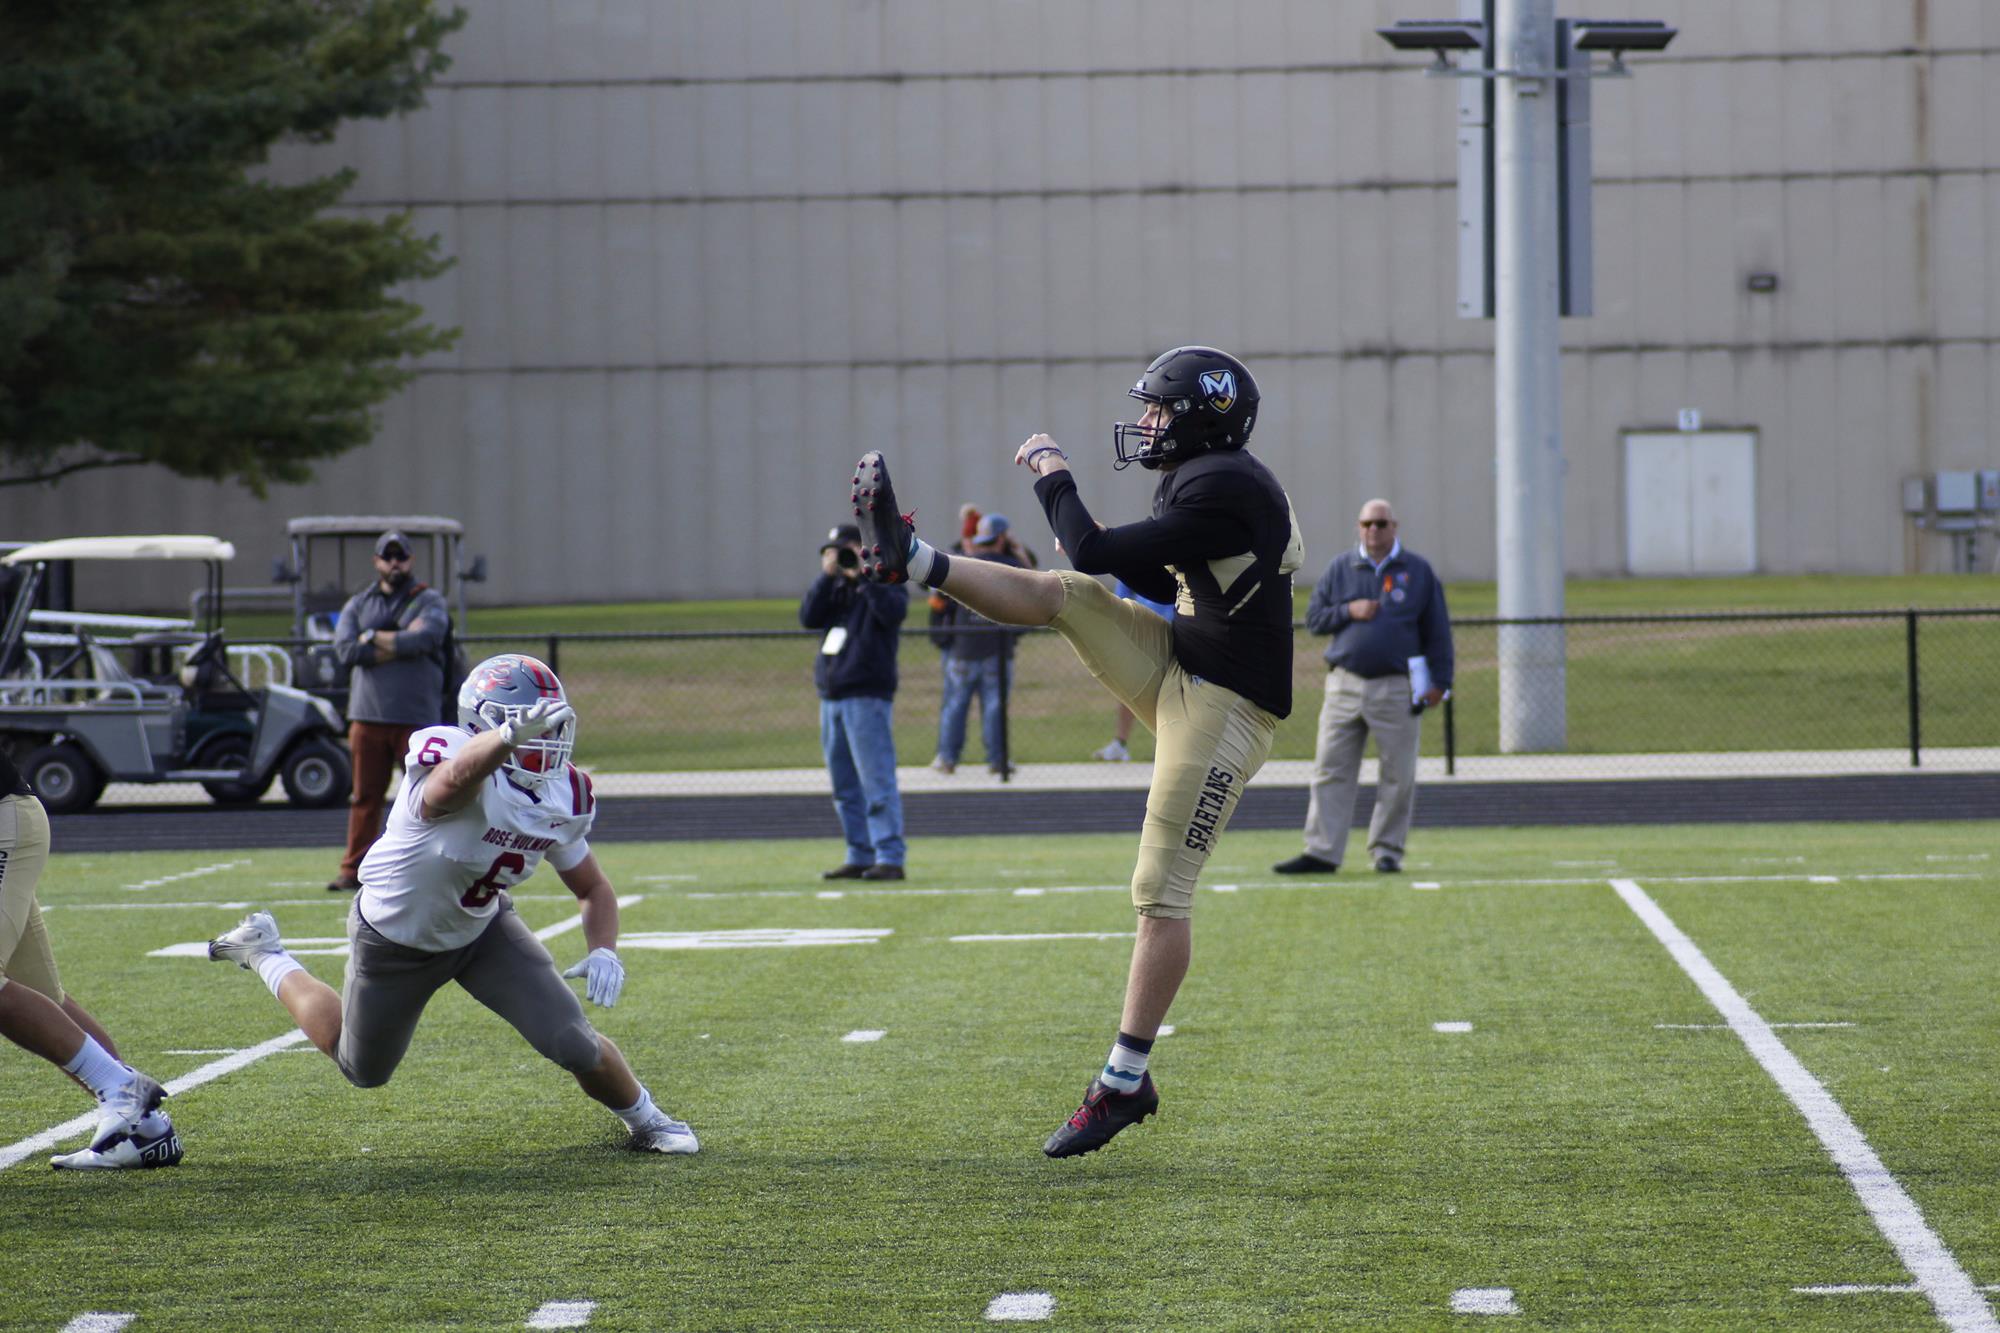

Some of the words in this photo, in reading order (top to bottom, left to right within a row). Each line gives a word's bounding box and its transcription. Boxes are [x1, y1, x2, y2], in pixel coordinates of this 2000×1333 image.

[1202, 371, 1235, 399] M
[417, 737, 448, 767] 6
[1185, 766, 1234, 852] SPARTANS
[481, 827, 557, 851] ROSE-HULMAN
[460, 851, 525, 908] 6
